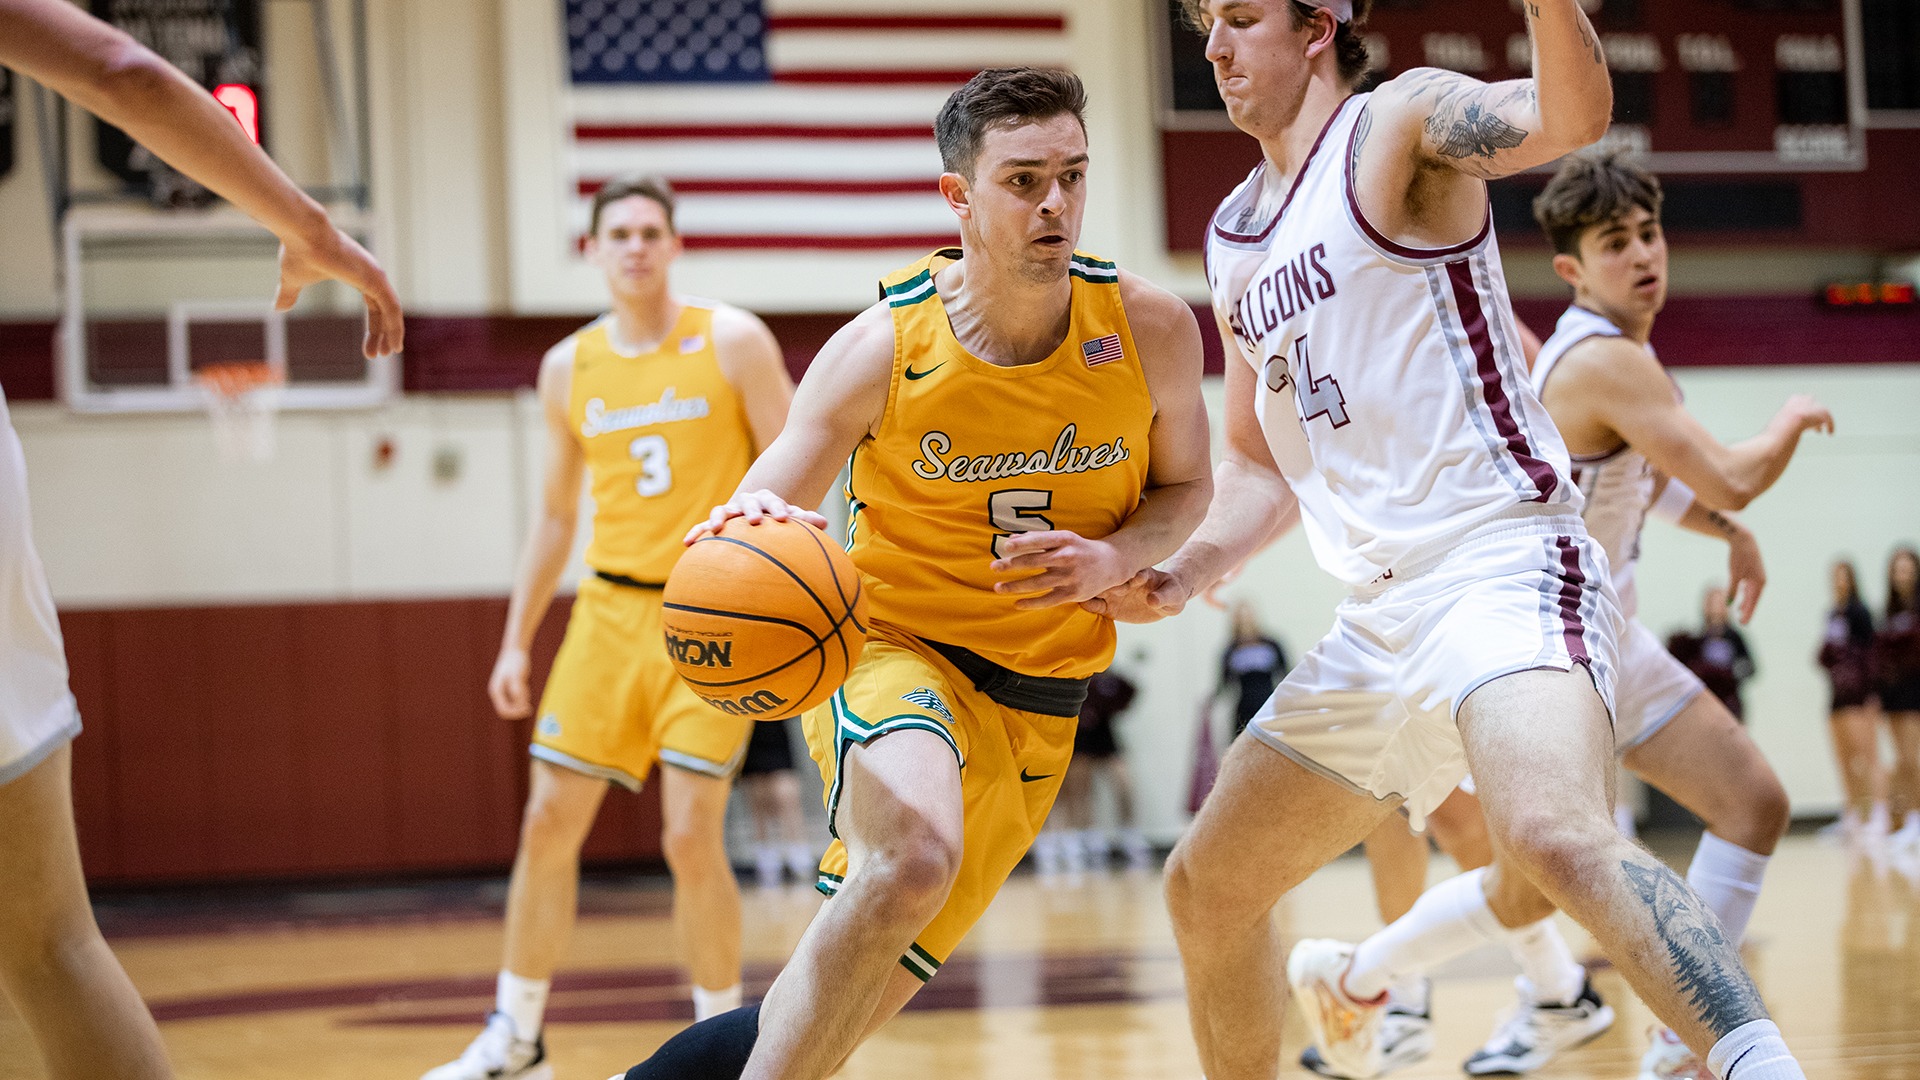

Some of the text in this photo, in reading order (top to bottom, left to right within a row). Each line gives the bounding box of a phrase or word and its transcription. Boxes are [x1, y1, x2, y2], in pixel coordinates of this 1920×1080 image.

[1229, 243, 1336, 348] ALCONS
[629, 434, 672, 497] 3
[912, 423, 1129, 483] Seawolves
[988, 489, 1055, 560] 5
[664, 631, 733, 668] NCAA
